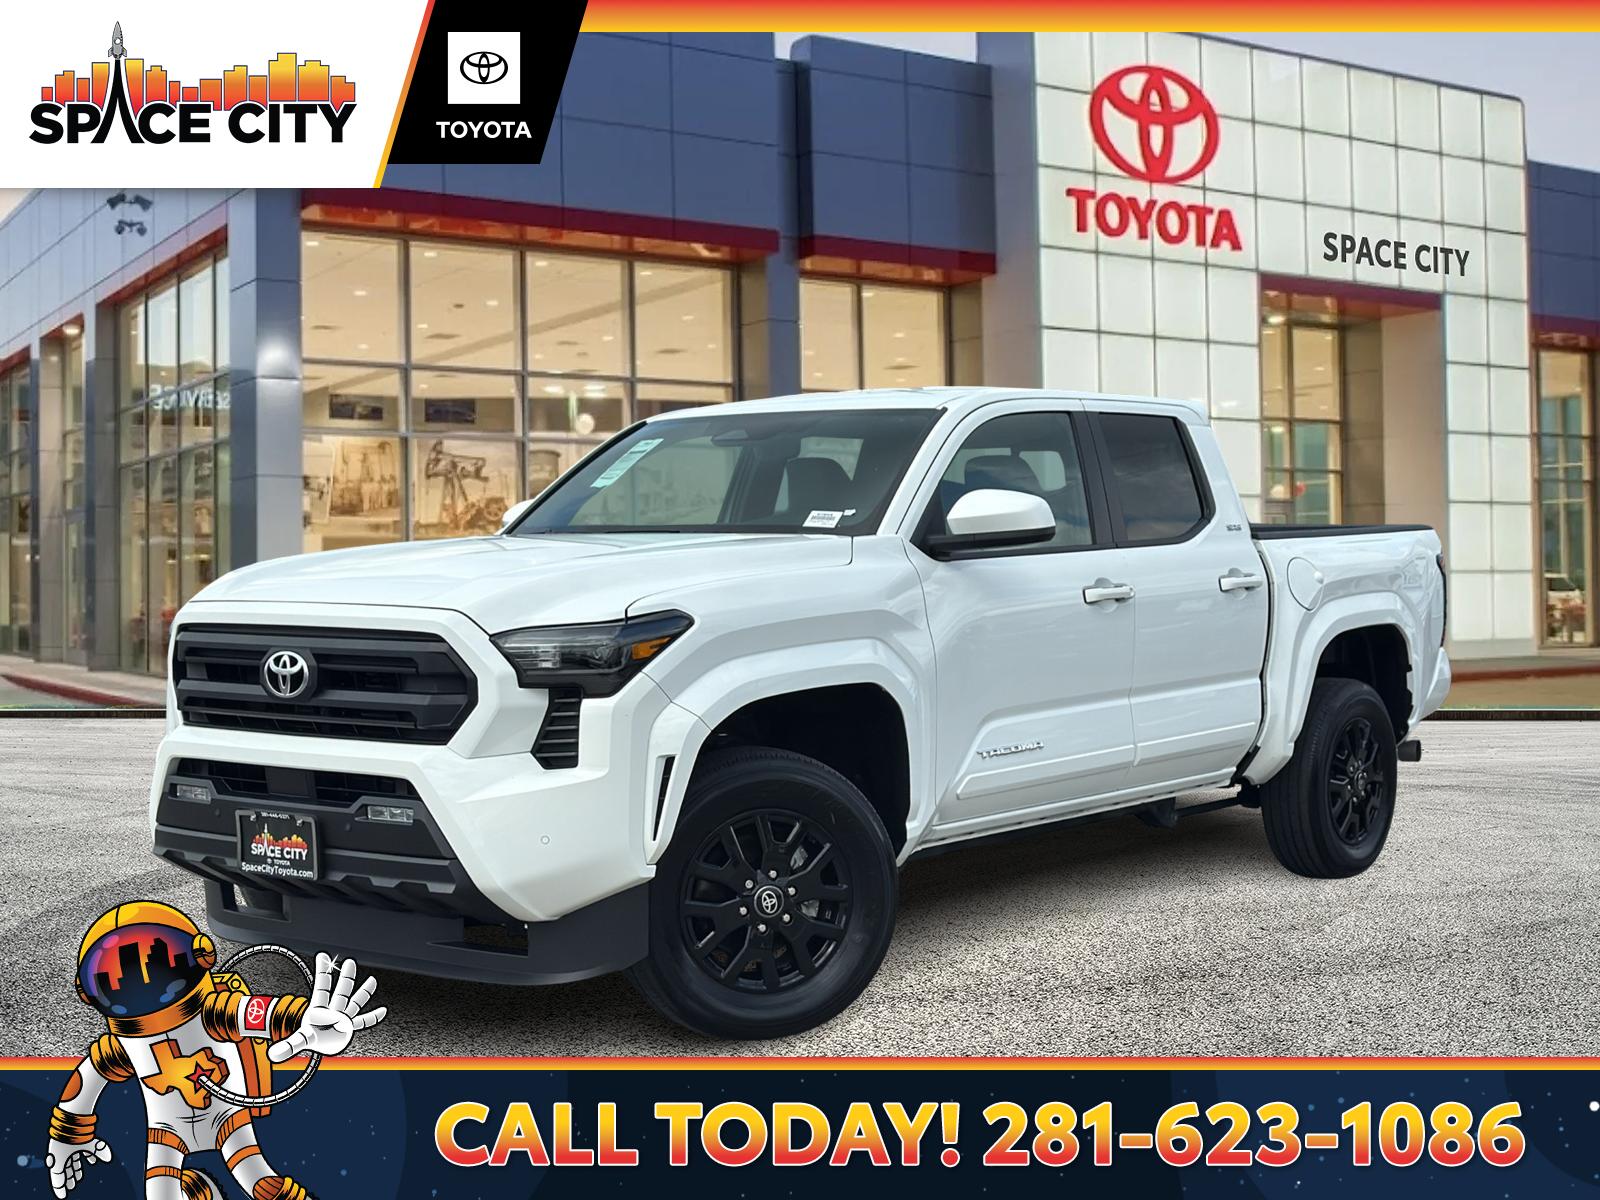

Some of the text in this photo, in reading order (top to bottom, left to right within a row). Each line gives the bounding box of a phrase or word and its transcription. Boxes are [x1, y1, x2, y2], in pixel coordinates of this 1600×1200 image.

[1066, 187, 1242, 251] TOYOTA
[1323, 232, 1470, 277] SPACE CITY
[976, 741, 1045, 760] TACOMA
[251, 842, 308, 860] SPACE CITY
[241, 861, 314, 879] SpaceCityToyota.com
